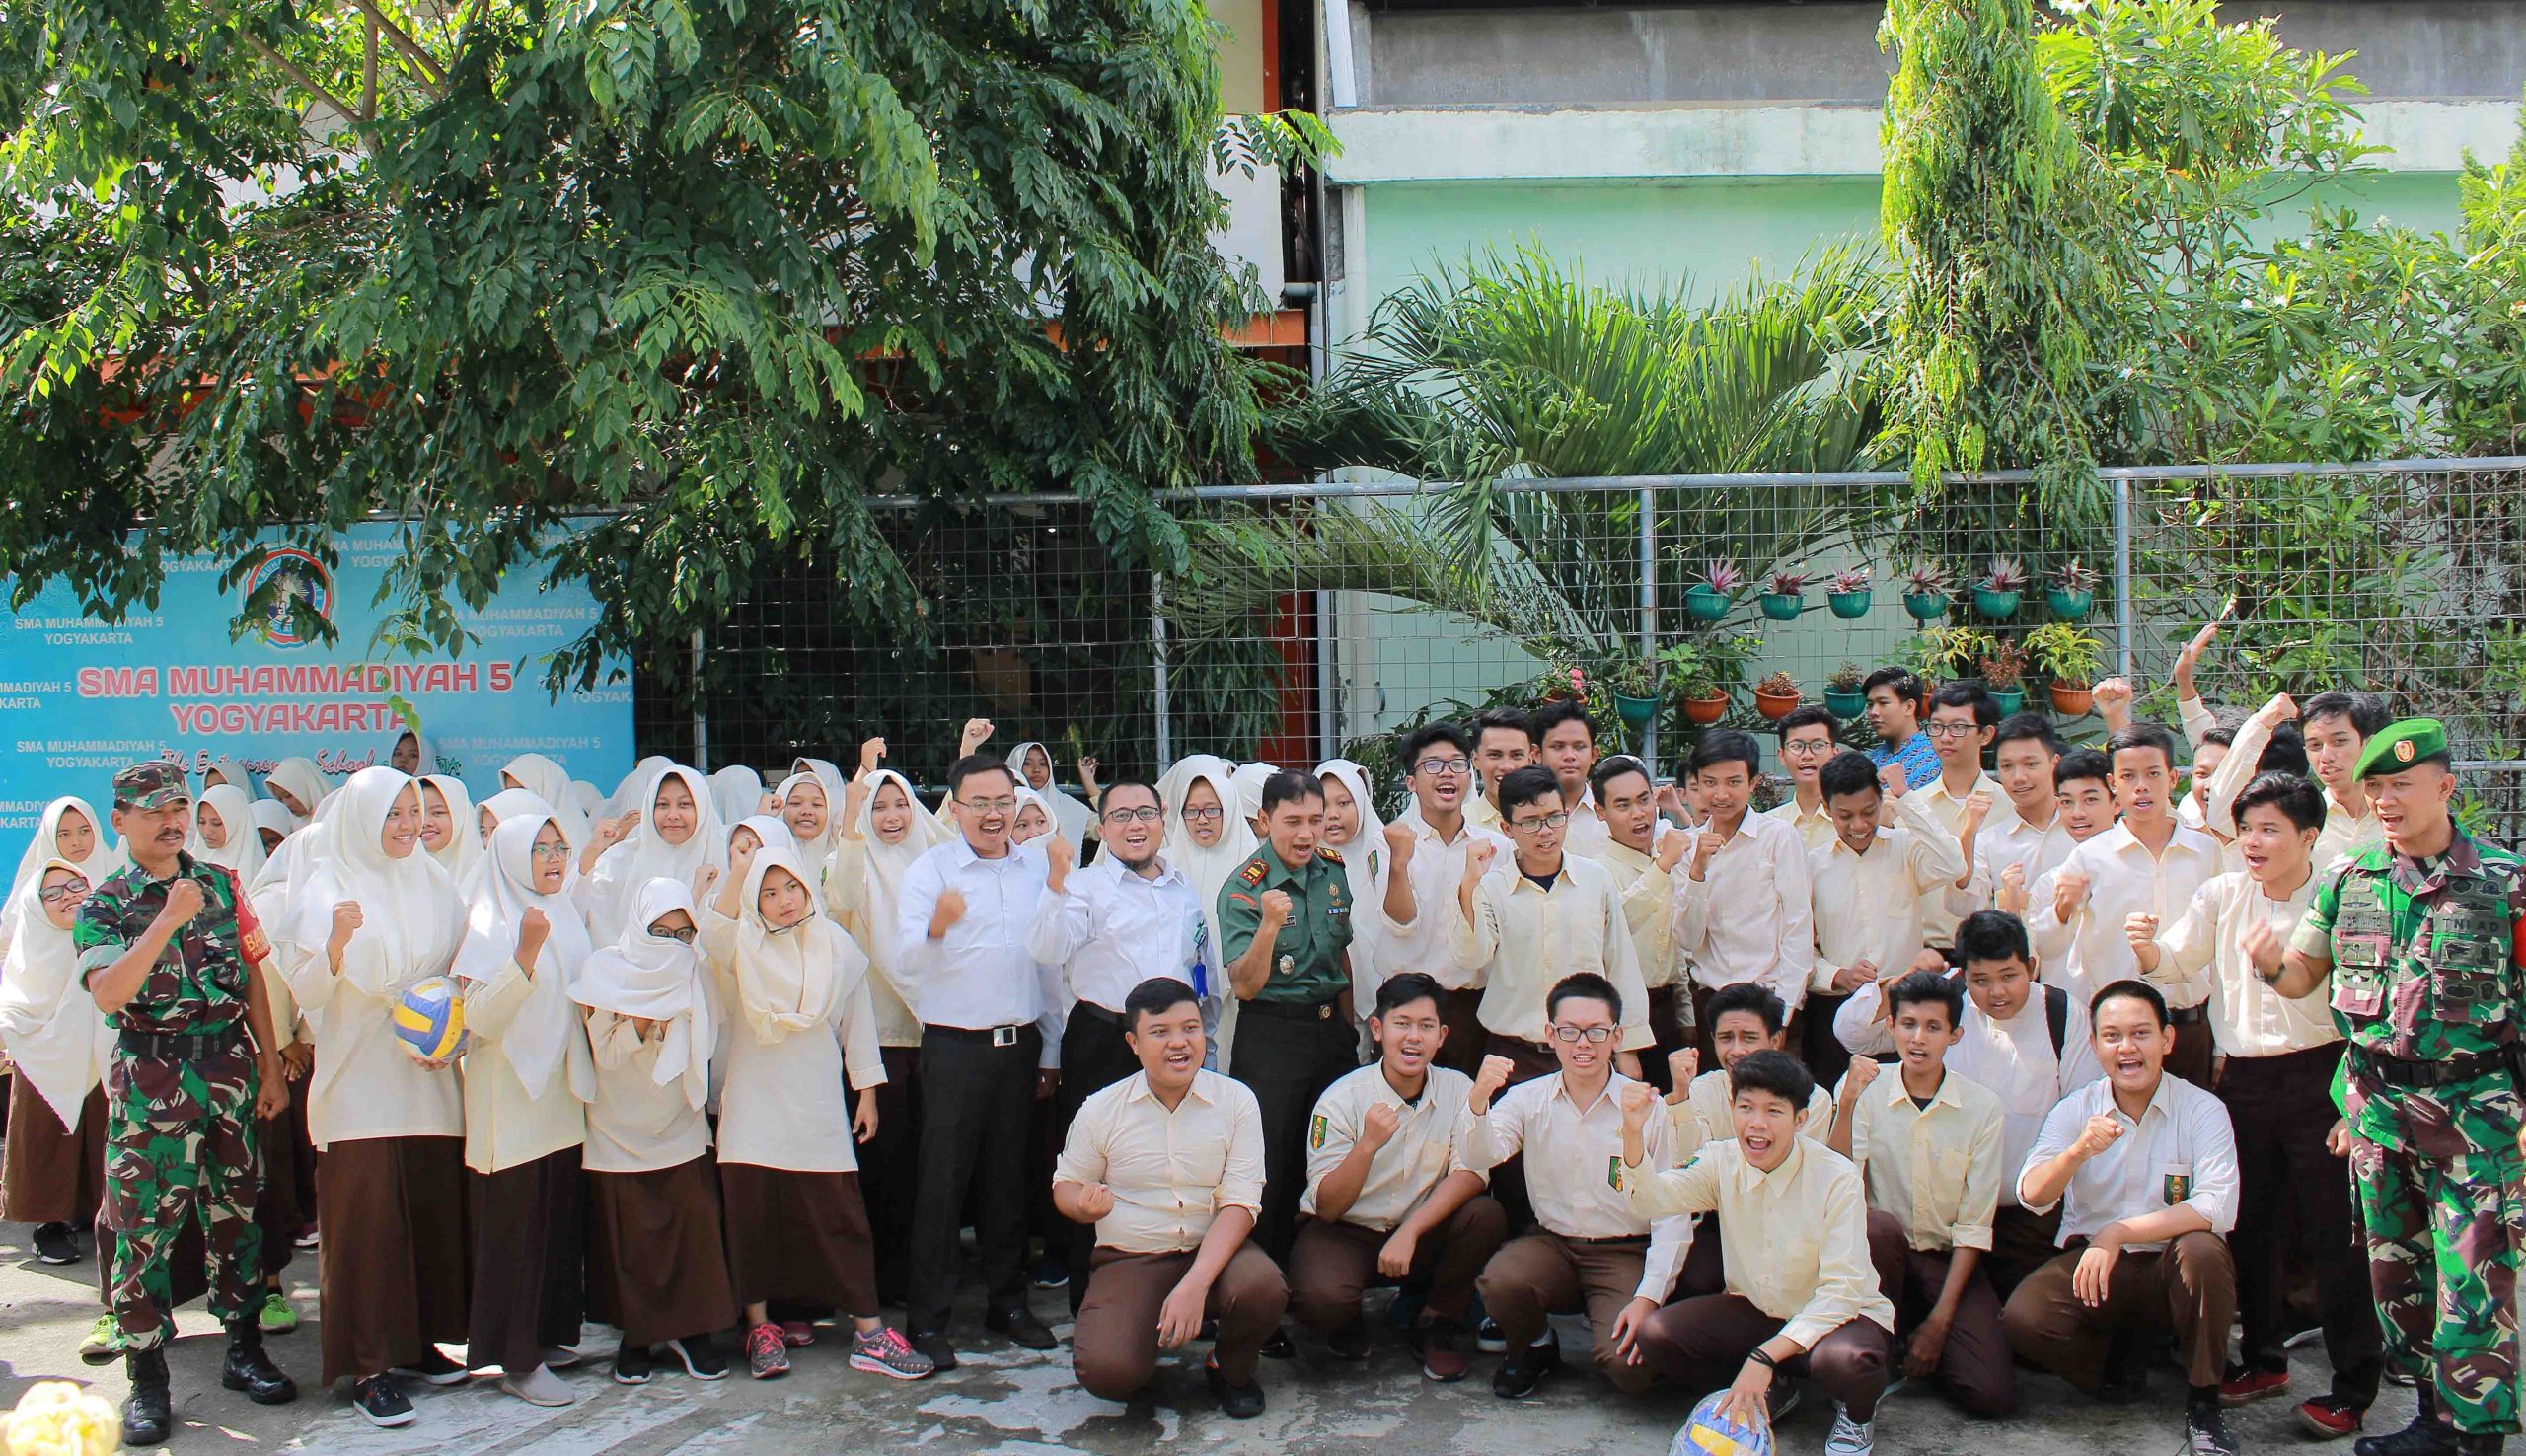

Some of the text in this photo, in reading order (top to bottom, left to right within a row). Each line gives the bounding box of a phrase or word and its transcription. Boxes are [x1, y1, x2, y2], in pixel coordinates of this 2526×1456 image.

[589, 608, 598, 619] 5
[15, 619, 42, 629] SMA
[156, 617, 164, 627] 5
[44, 633, 133, 645] YOGYAKARTA
[78, 668, 158, 696] SMA
[169, 663, 478, 695] MUHAMMADIYAH
[489, 663, 512, 691] 5
[63, 682, 72, 692] 5
[17, 741, 44, 753] SMA
[47, 741, 155, 753] MUHAMMADIYAH
[593, 736, 601, 749] 5
[46, 757, 134, 768] YOGYAKARTA
[2442, 918, 2471, 930] TNI
